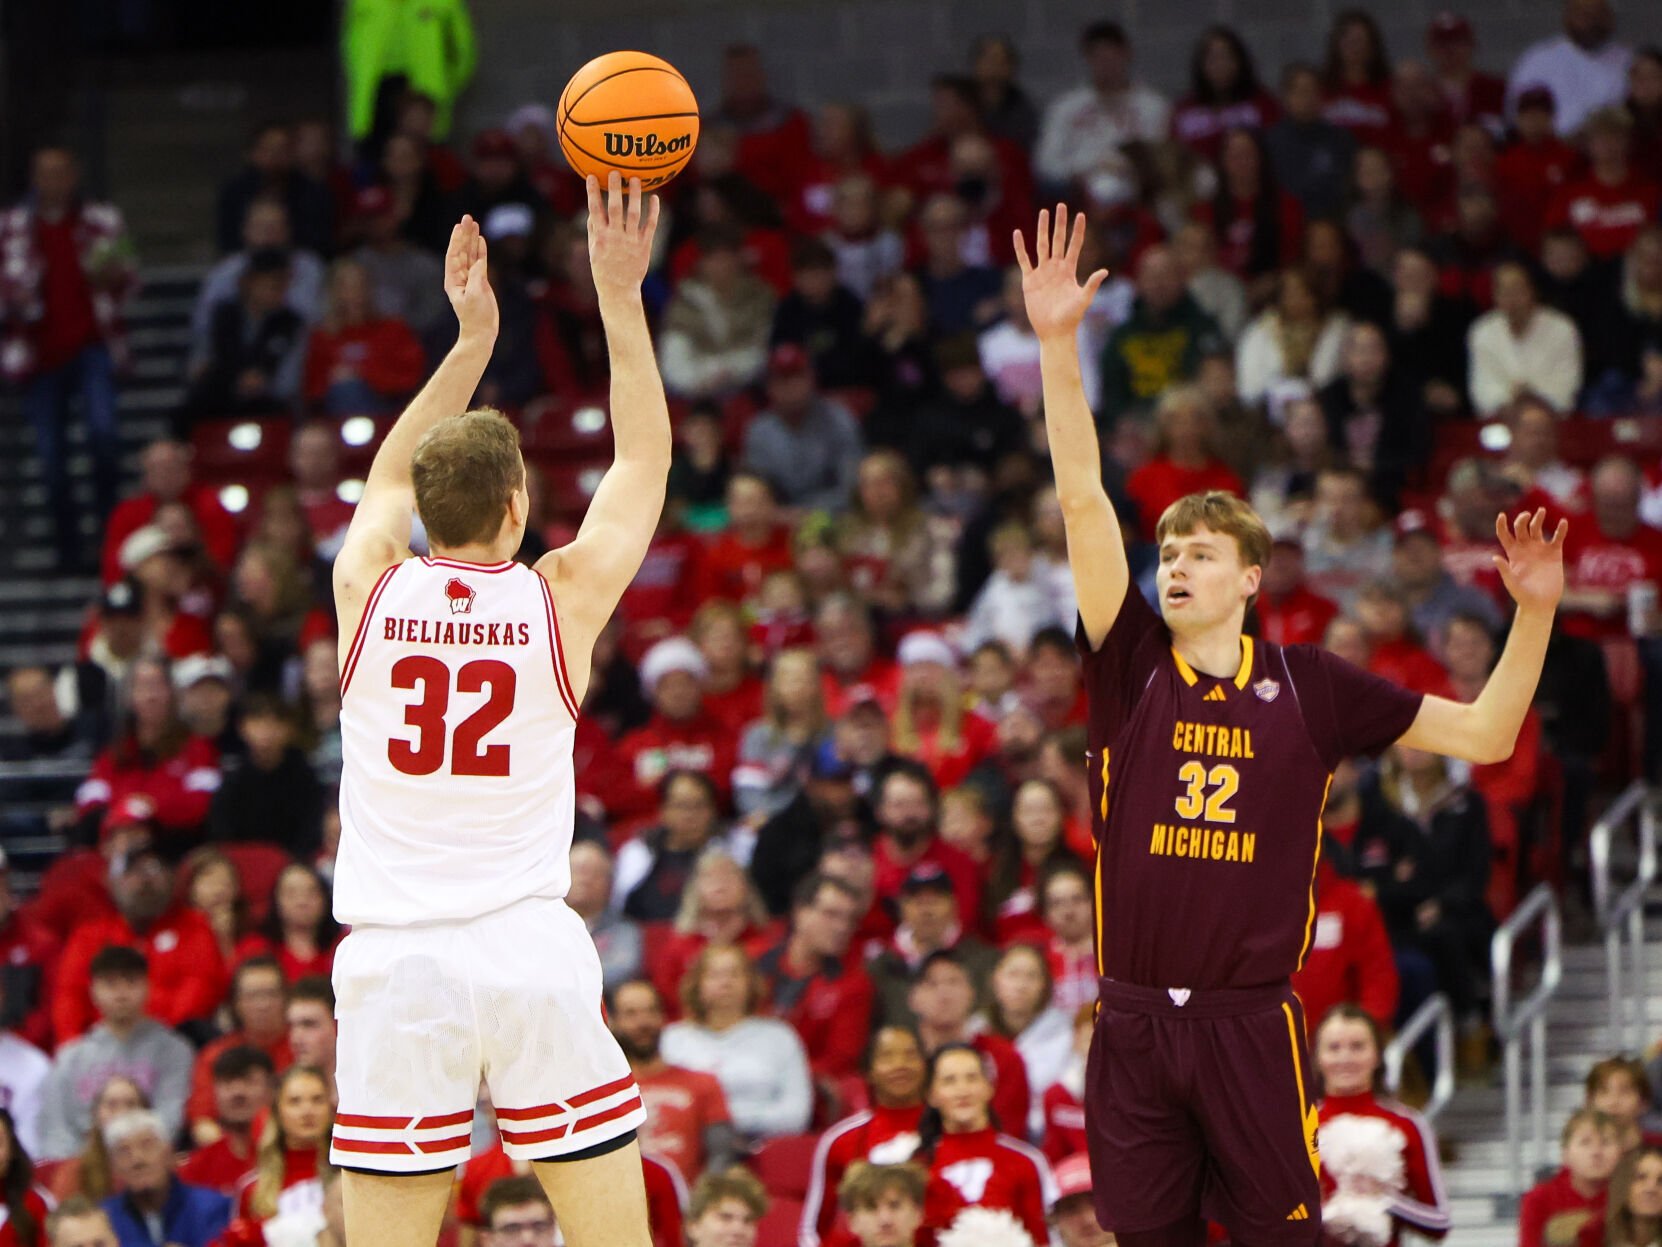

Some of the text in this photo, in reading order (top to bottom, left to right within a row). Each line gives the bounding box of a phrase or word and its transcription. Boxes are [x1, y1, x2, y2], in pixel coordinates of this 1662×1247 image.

[604, 132, 691, 156] Wilson
[384, 617, 530, 646] BIELIAUSKAS
[388, 655, 517, 777] 32
[1172, 720, 1255, 759] CENTRAL
[1175, 760, 1240, 824] 32
[1149, 824, 1256, 862] MICHIGAN
